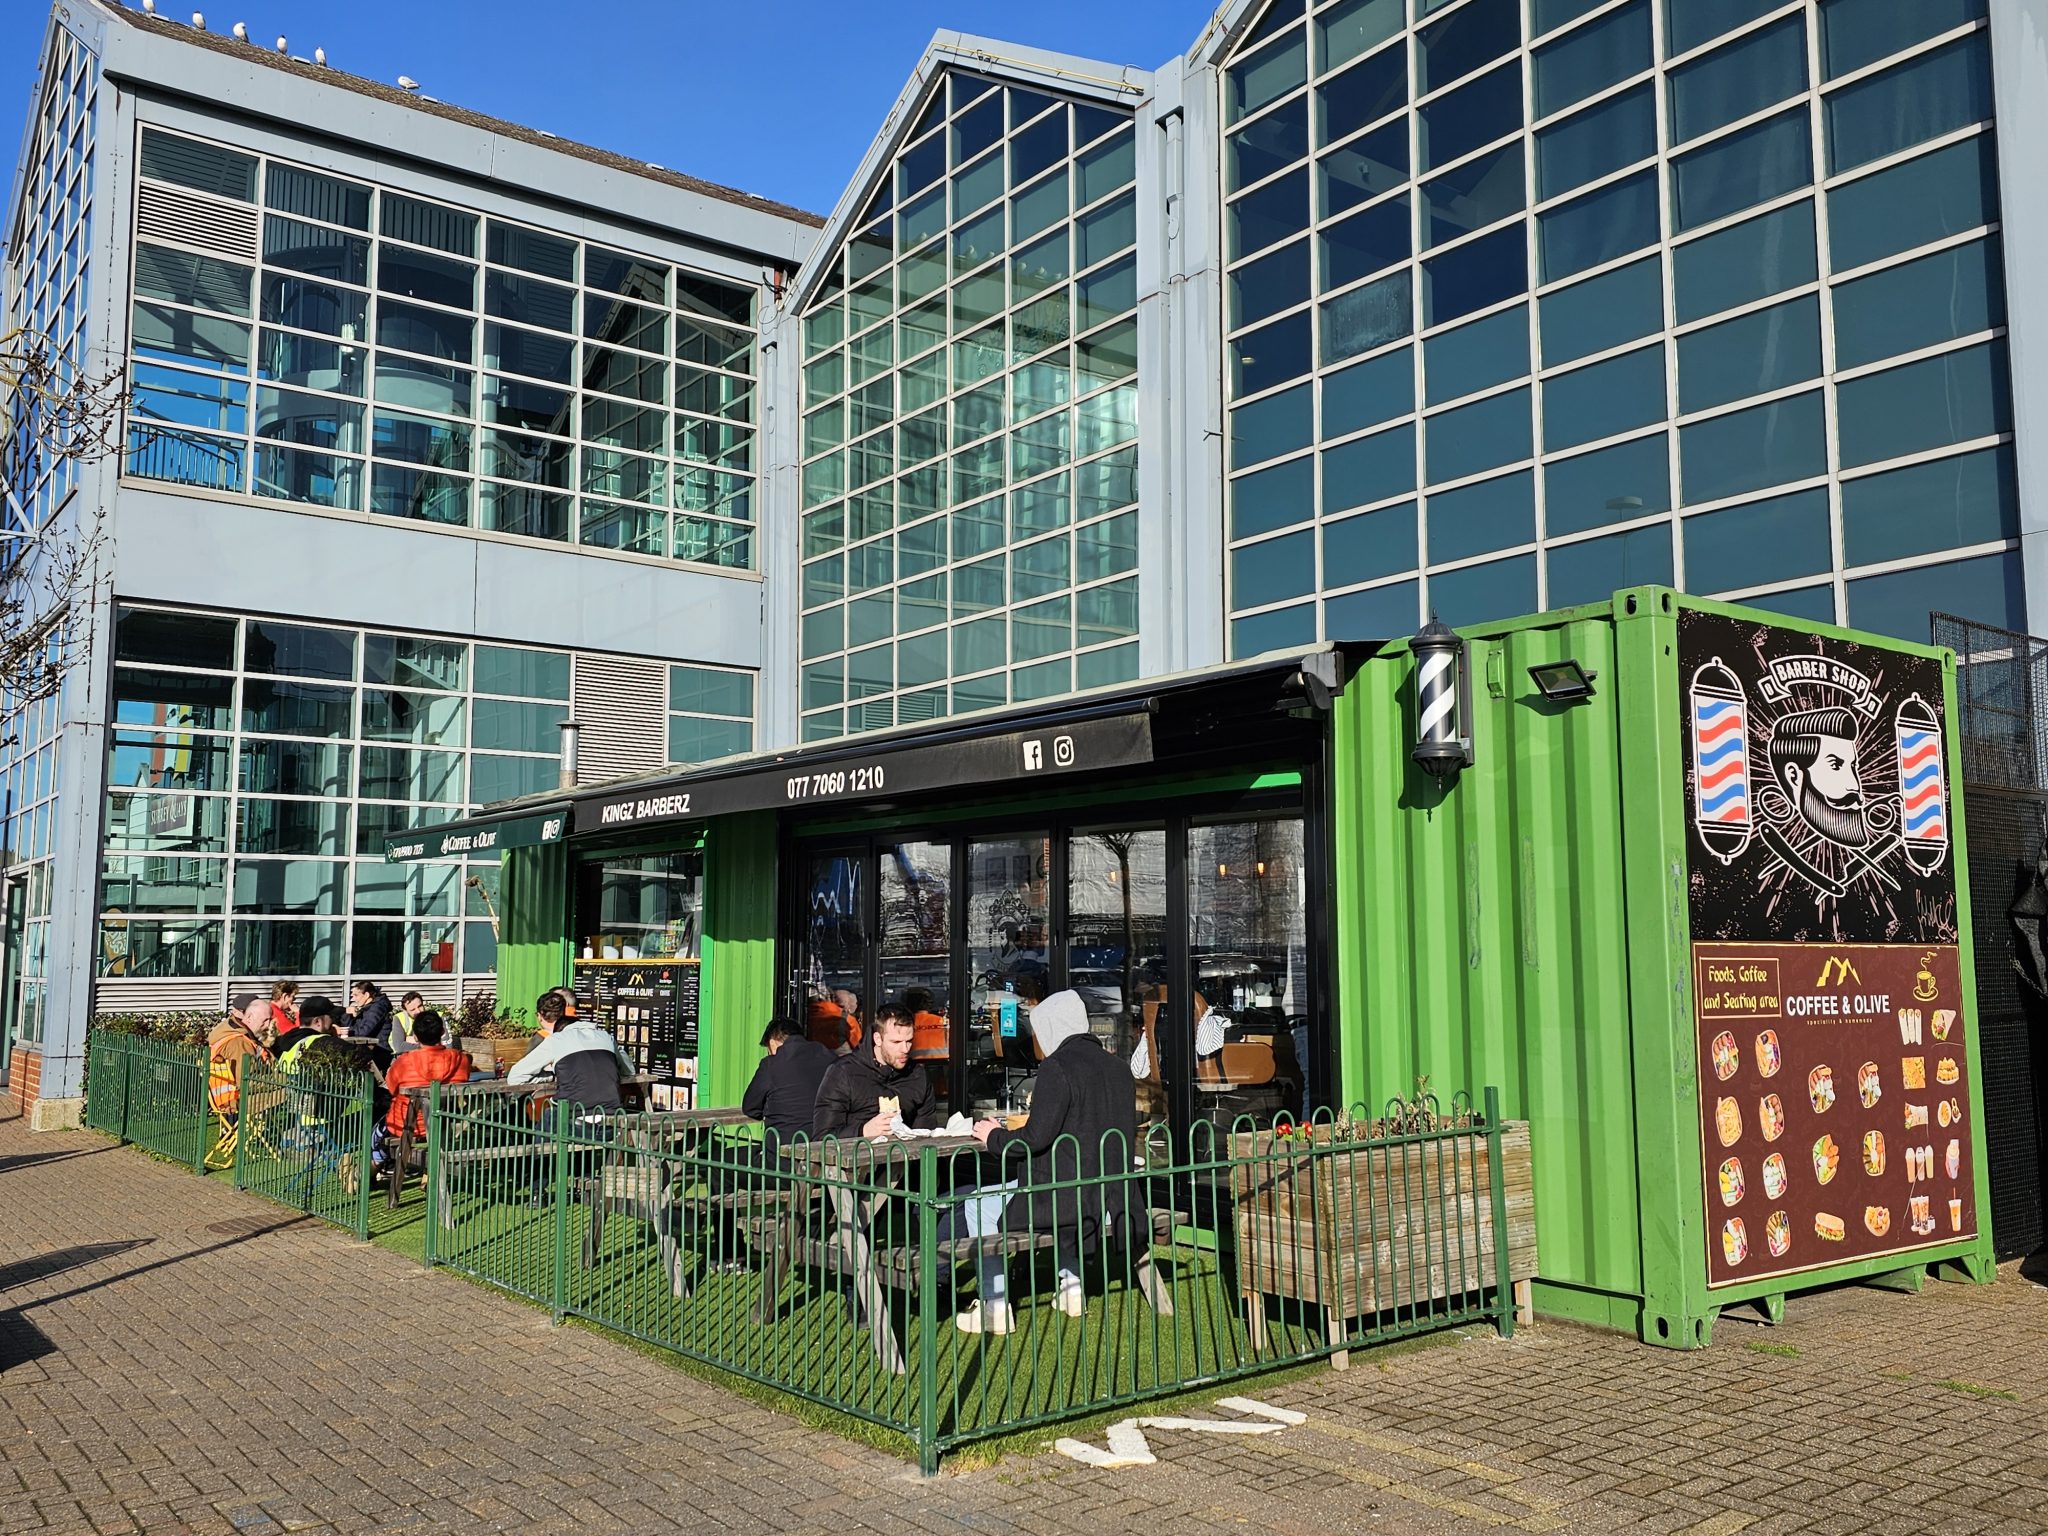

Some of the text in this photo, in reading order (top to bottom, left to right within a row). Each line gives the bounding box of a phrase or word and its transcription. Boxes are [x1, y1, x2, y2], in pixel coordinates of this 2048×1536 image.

[1775, 660, 1867, 693] BARBER SHOP
[787, 765, 884, 799] 077 7060 1210
[601, 793, 691, 824] KINGZ BARBERZ
[448, 836, 472, 851] COFFEE
[472, 836, 478, 848] &
[1708, 965, 1767, 984] Foods, Coffee
[617, 987, 636, 996] COFFEE
[640, 988, 654, 997] OLIVE
[1704, 992, 1779, 1012] and Seating area
[1786, 994, 1891, 1017] COFFEE & OLIVE
